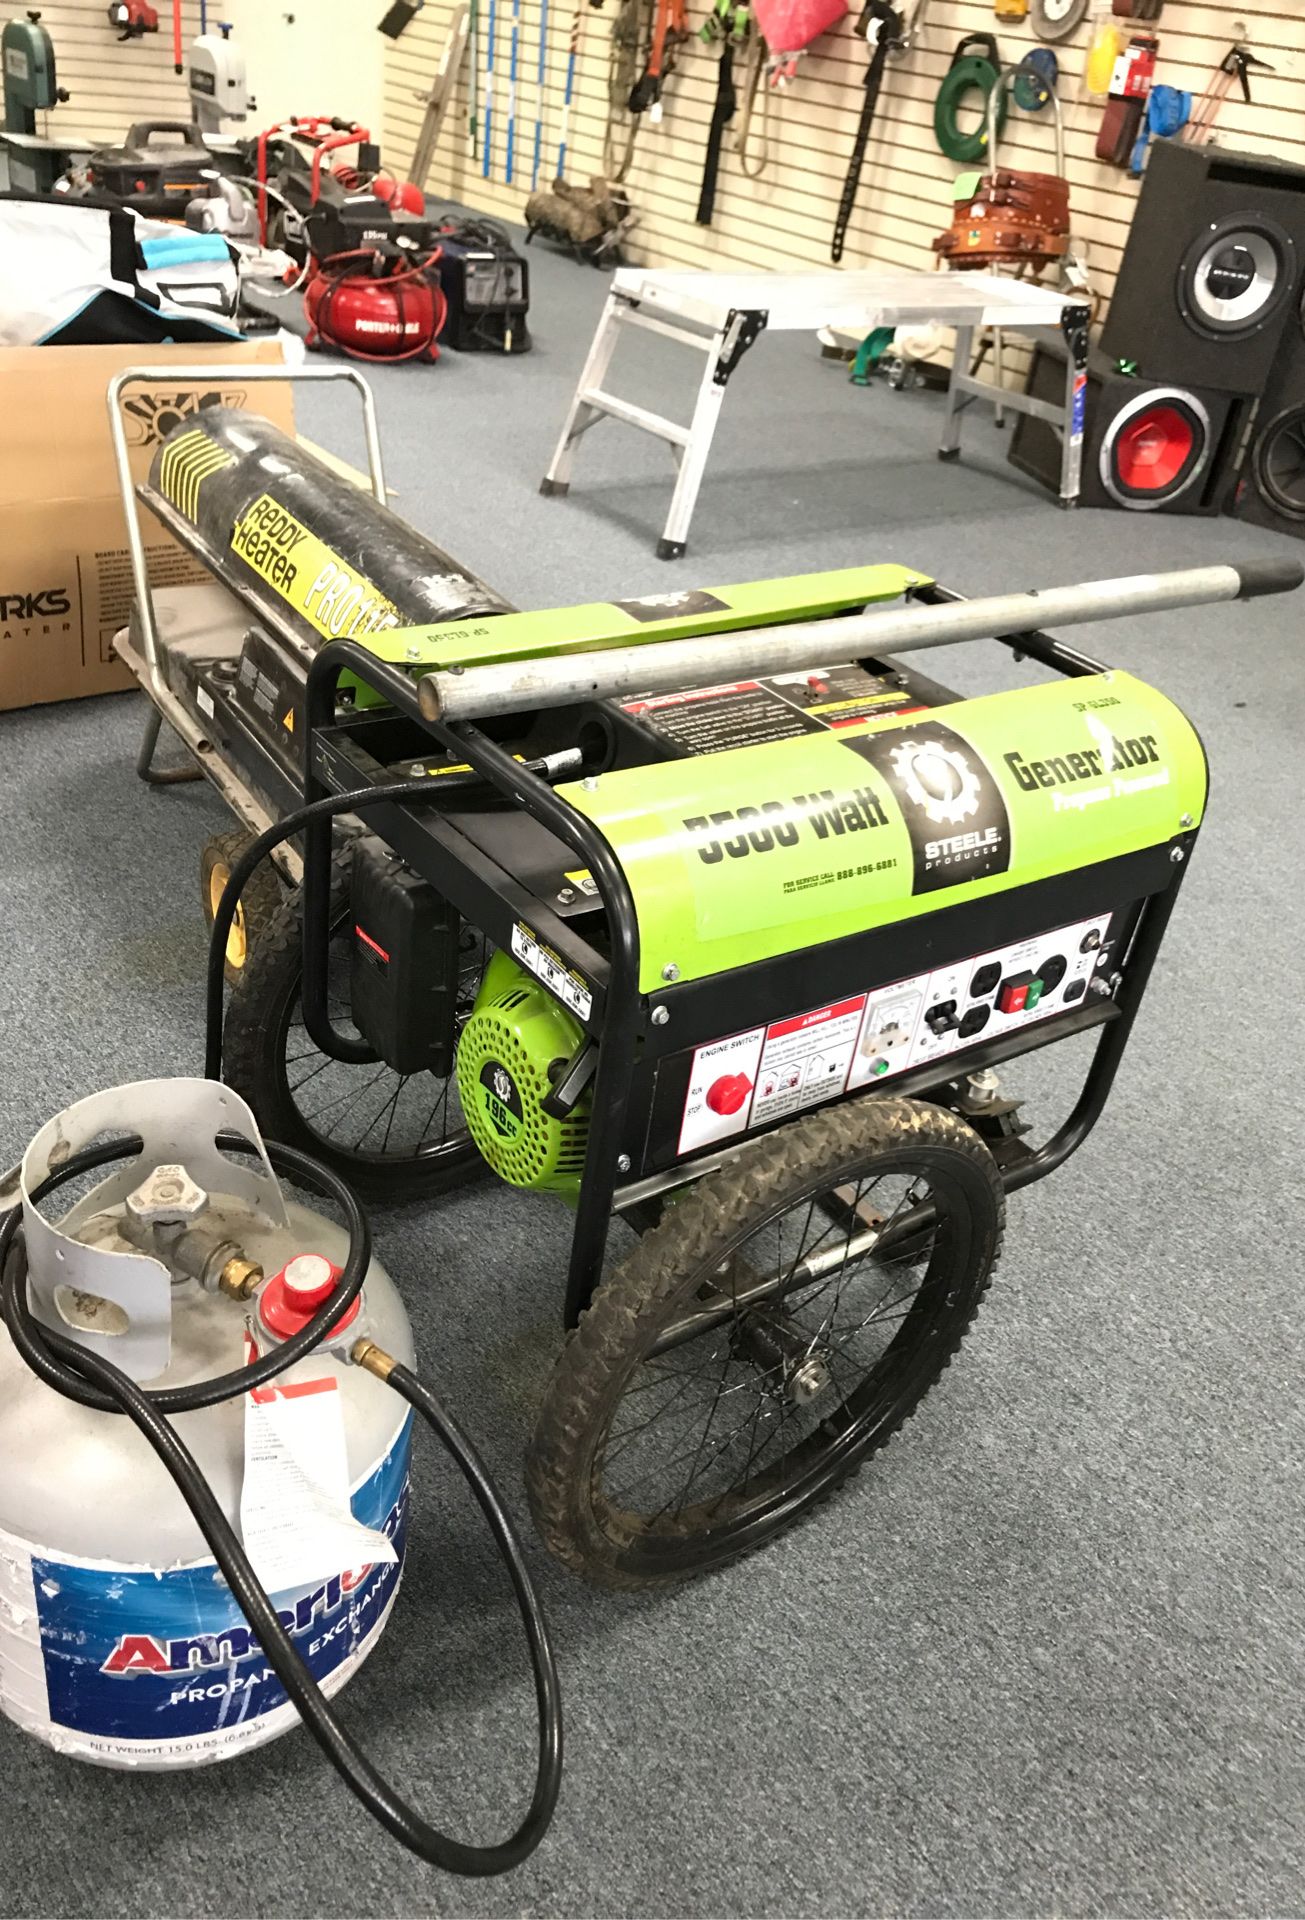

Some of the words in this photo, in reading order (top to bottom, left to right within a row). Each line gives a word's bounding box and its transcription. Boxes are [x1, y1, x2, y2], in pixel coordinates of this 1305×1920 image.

[792, 786, 890, 840] Watt
[925, 845, 998, 871] products
[807, 1009, 832, 1023] DANGER
[700, 1041, 729, 1060] ENGINE
[730, 1033, 760, 1050] SWITCH
[691, 1086, 703, 1097] RUN
[169, 1668, 279, 1704] PROPAN
[115, 1744, 163, 1755] WEIGHT
